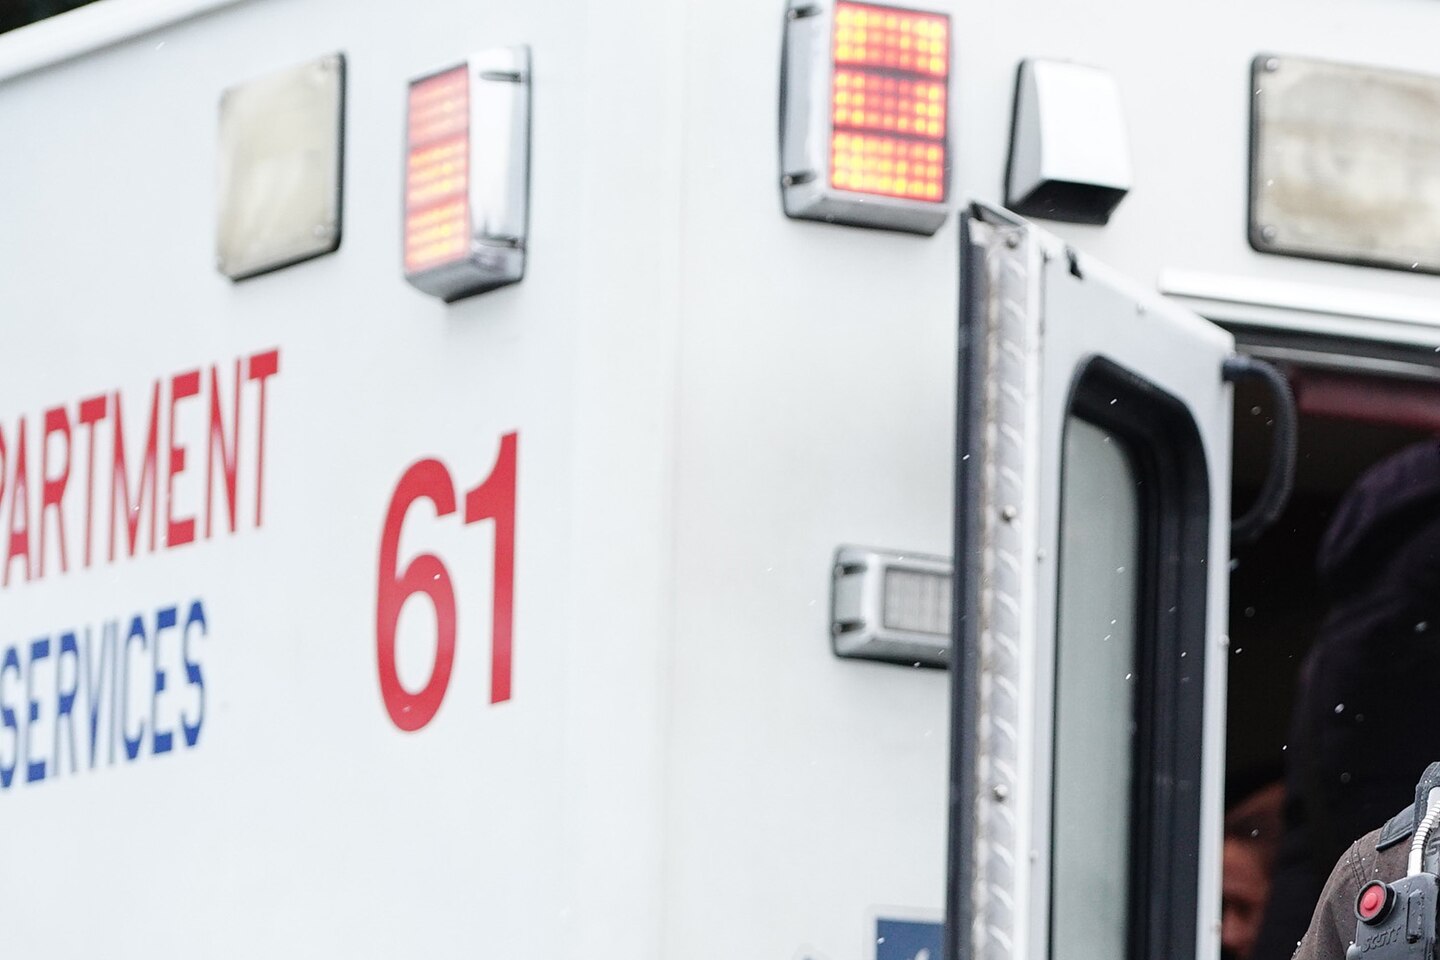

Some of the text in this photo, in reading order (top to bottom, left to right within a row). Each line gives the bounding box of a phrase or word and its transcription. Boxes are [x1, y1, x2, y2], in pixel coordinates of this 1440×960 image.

[0, 346, 281, 588] ARTMENT
[376, 430, 519, 733] 61
[0, 597, 209, 790] SERVICES
